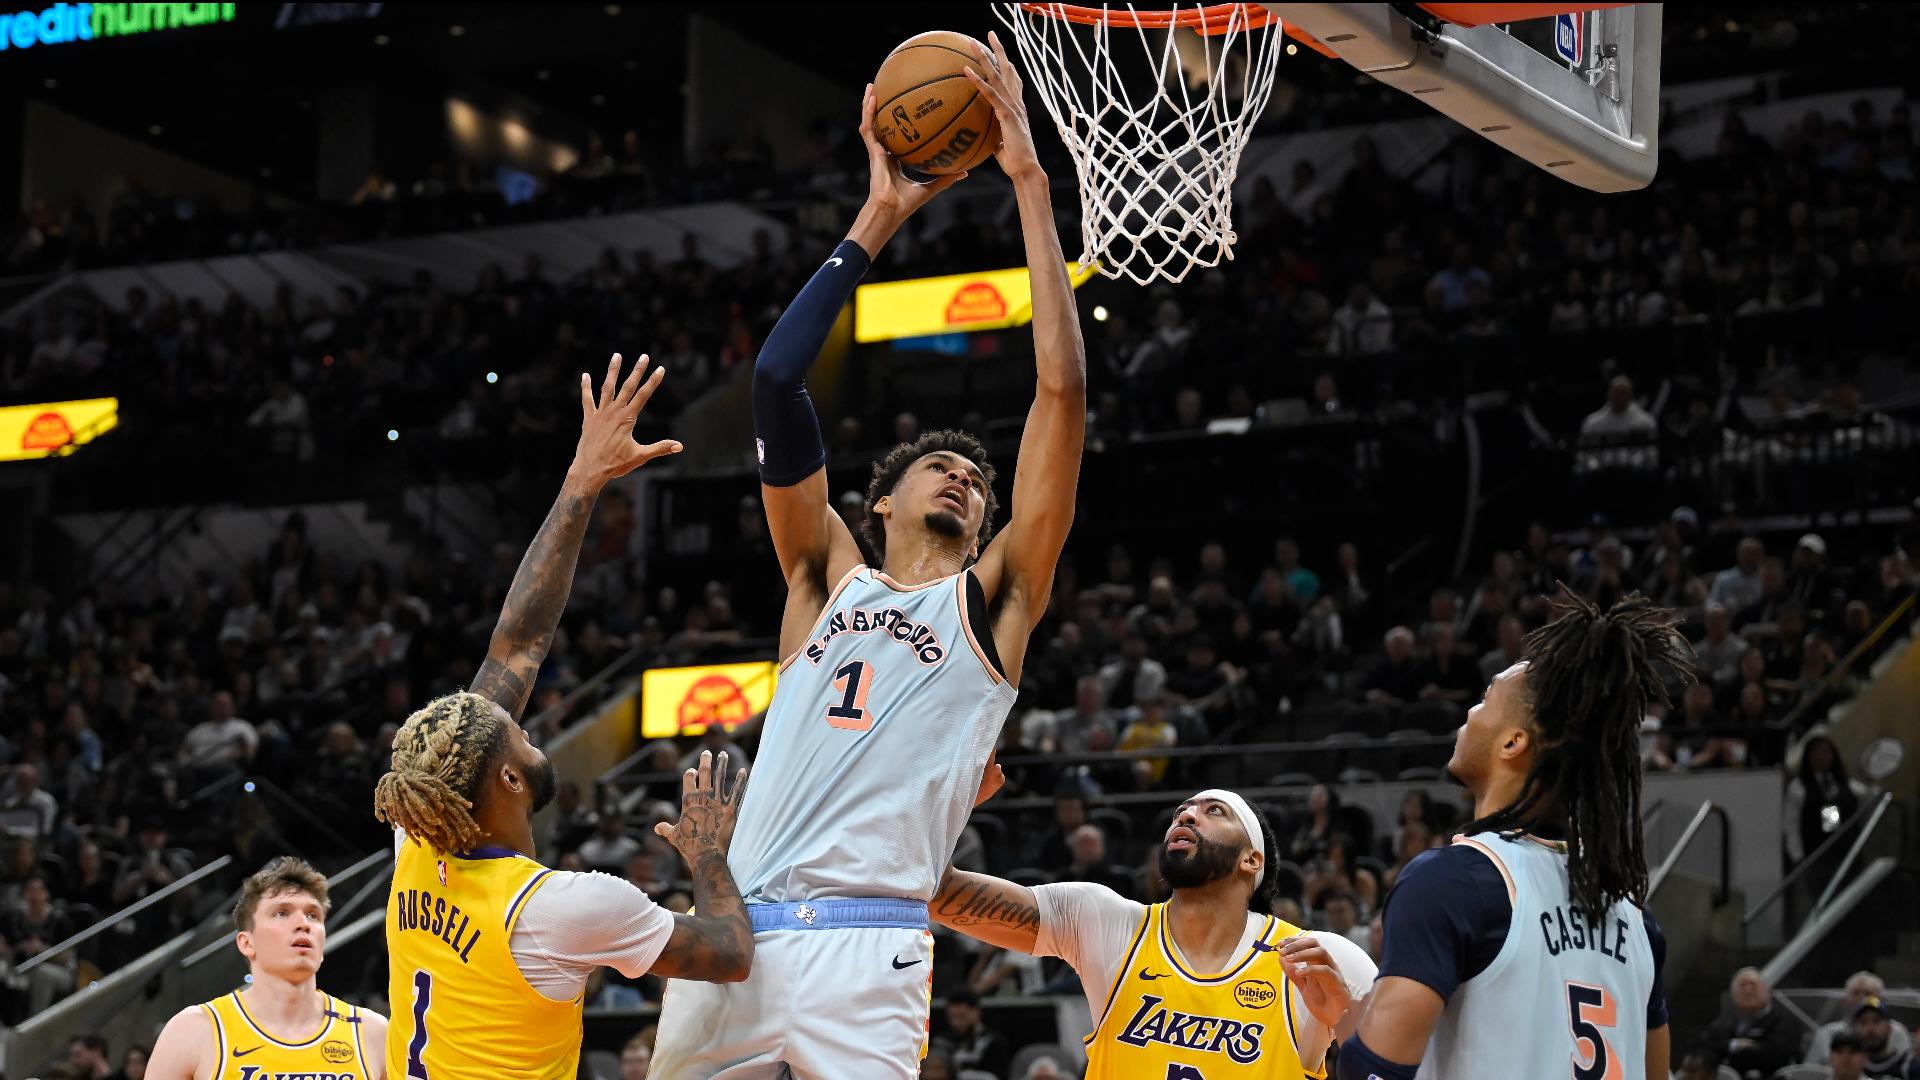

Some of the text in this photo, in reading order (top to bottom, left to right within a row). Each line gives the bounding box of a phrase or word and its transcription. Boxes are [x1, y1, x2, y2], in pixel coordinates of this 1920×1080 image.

[1559, 21, 1573, 53] NBA
[852, 608, 944, 665] ANTONIO
[827, 660, 872, 729] 1
[397, 889, 481, 964] RUSSELL
[407, 969, 432, 1080] 1
[1238, 986, 1273, 1001] bibigo
[1116, 994, 1265, 1064] LAKERS
[1567, 980, 1615, 1080] 5
